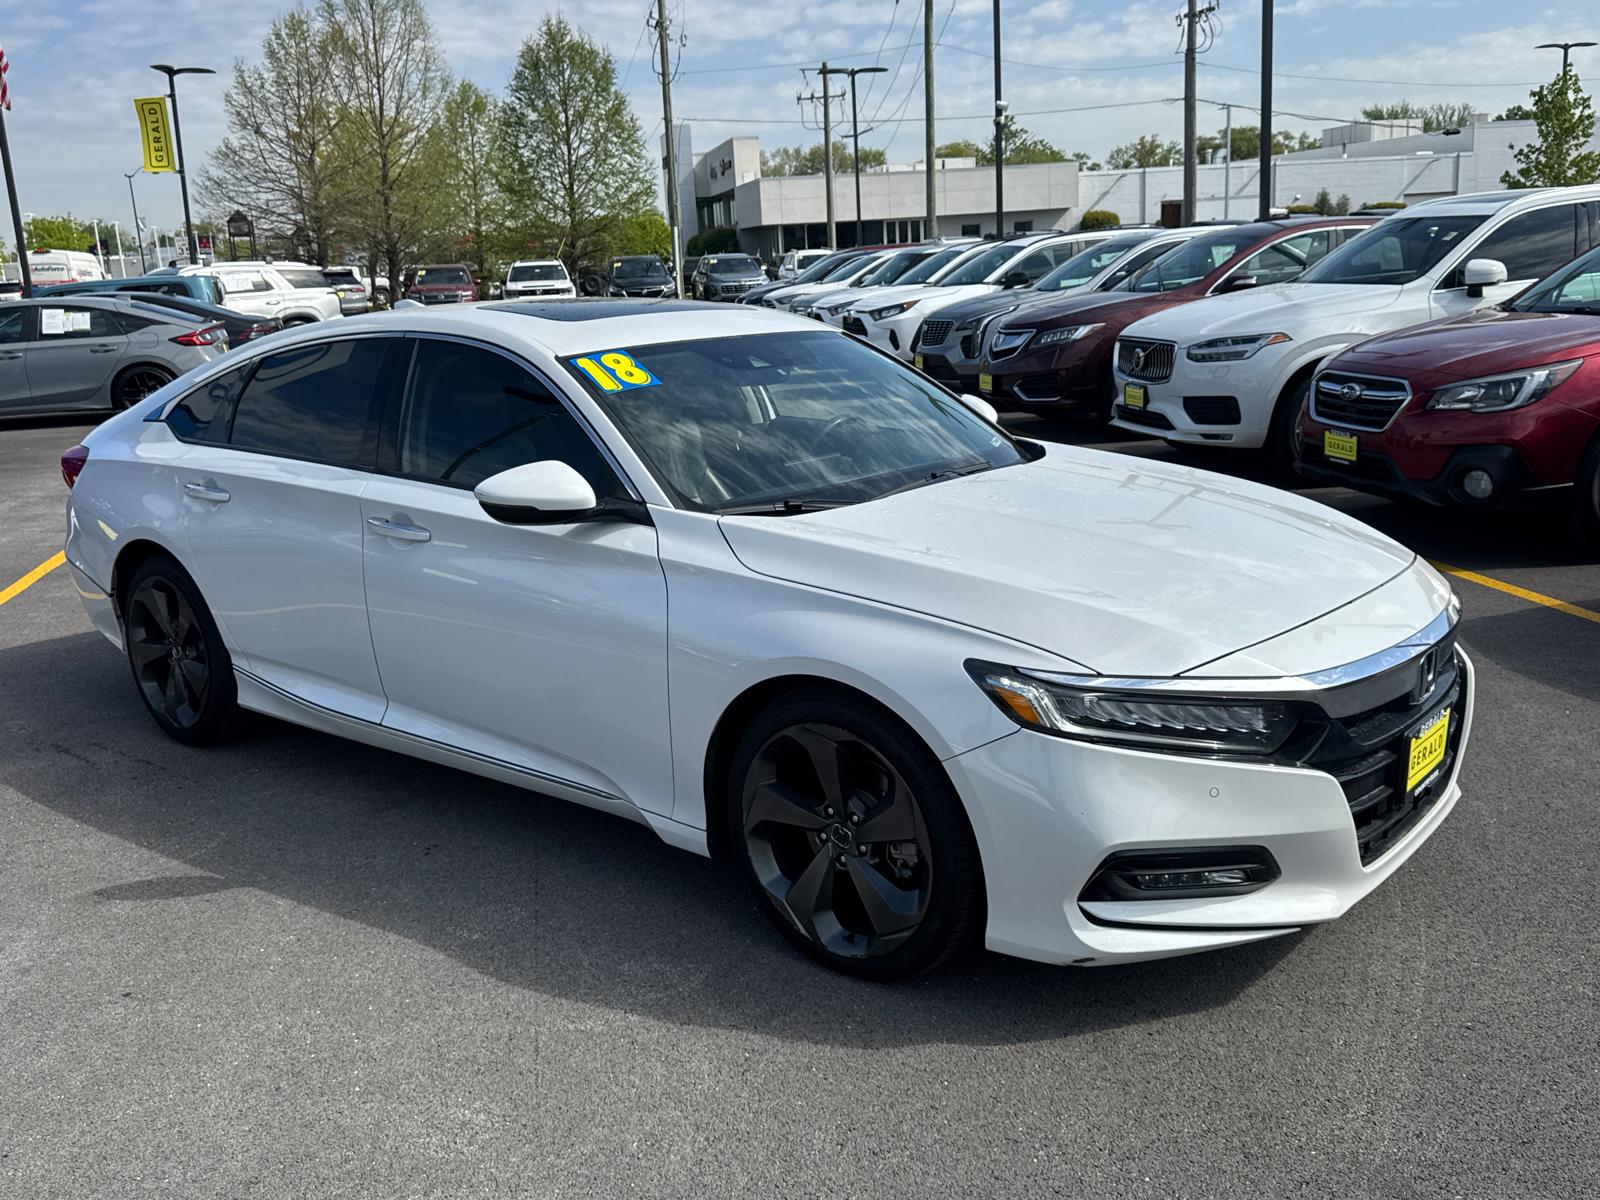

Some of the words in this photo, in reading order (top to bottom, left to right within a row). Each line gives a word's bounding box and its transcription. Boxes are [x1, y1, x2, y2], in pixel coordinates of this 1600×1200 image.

[148, 107, 164, 163] GERALD
[576, 352, 652, 391] 18
[1328, 441, 1353, 453] GERALD
[1411, 734, 1443, 771] GERALD
